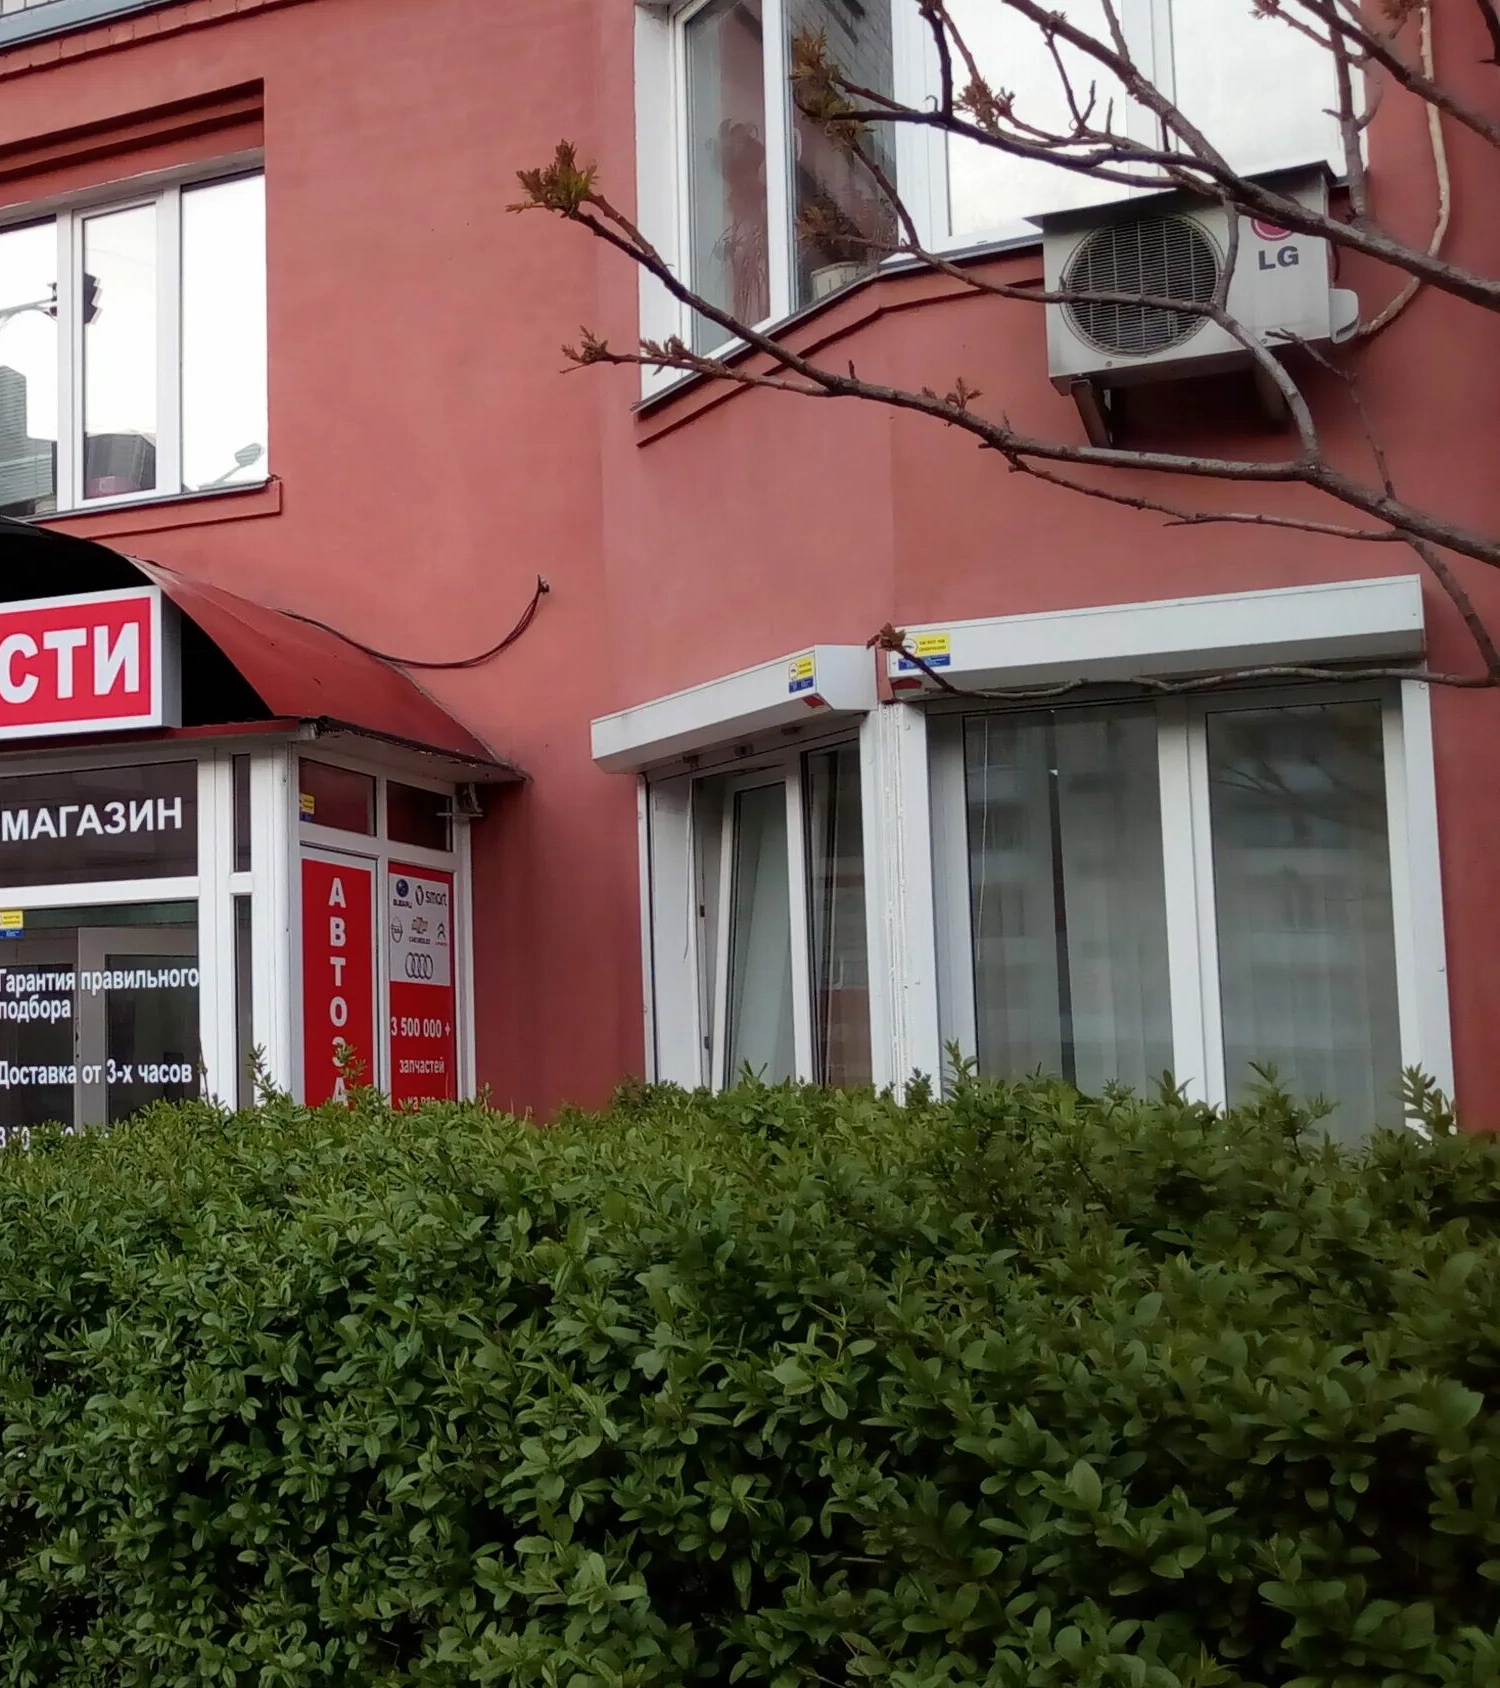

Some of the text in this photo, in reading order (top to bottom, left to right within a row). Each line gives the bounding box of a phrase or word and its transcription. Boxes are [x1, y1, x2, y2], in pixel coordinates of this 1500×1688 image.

[1259, 245, 1299, 270] LG
[1, 797, 182, 842] МАГАЗИН
[81, 967, 200, 996] правильного
[391, 1016, 398, 1036] 3
[400, 1017, 420, 1037] 500
[423, 1018, 442, 1038] 000
[82, 1066, 102, 1084] от
[106, 1059, 133, 1084] 3-х
[138, 1063, 192, 1084] часов
[400, 1056, 445, 1074] запчастей
